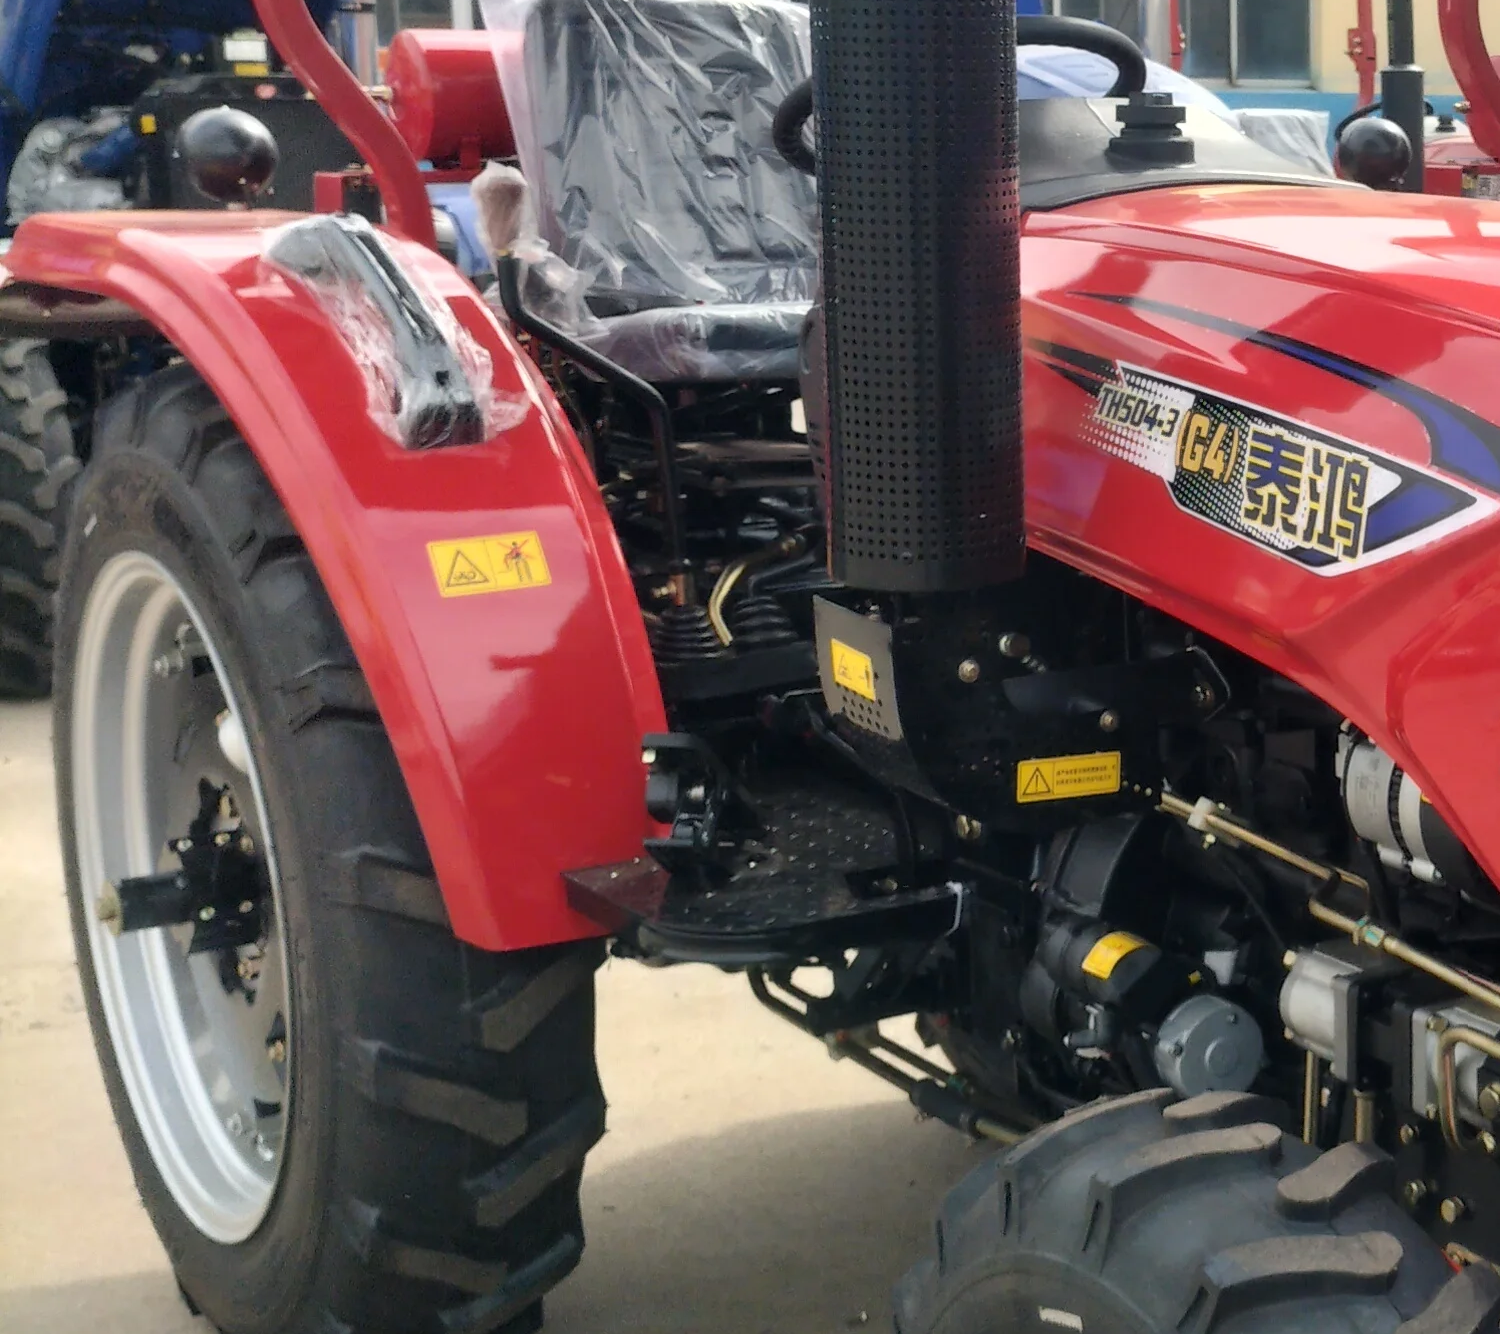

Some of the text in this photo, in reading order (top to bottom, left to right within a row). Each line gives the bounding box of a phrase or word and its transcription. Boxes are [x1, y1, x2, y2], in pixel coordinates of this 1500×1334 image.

[1096, 383, 1370, 561] TH504-3 (G4) 泰鸿
